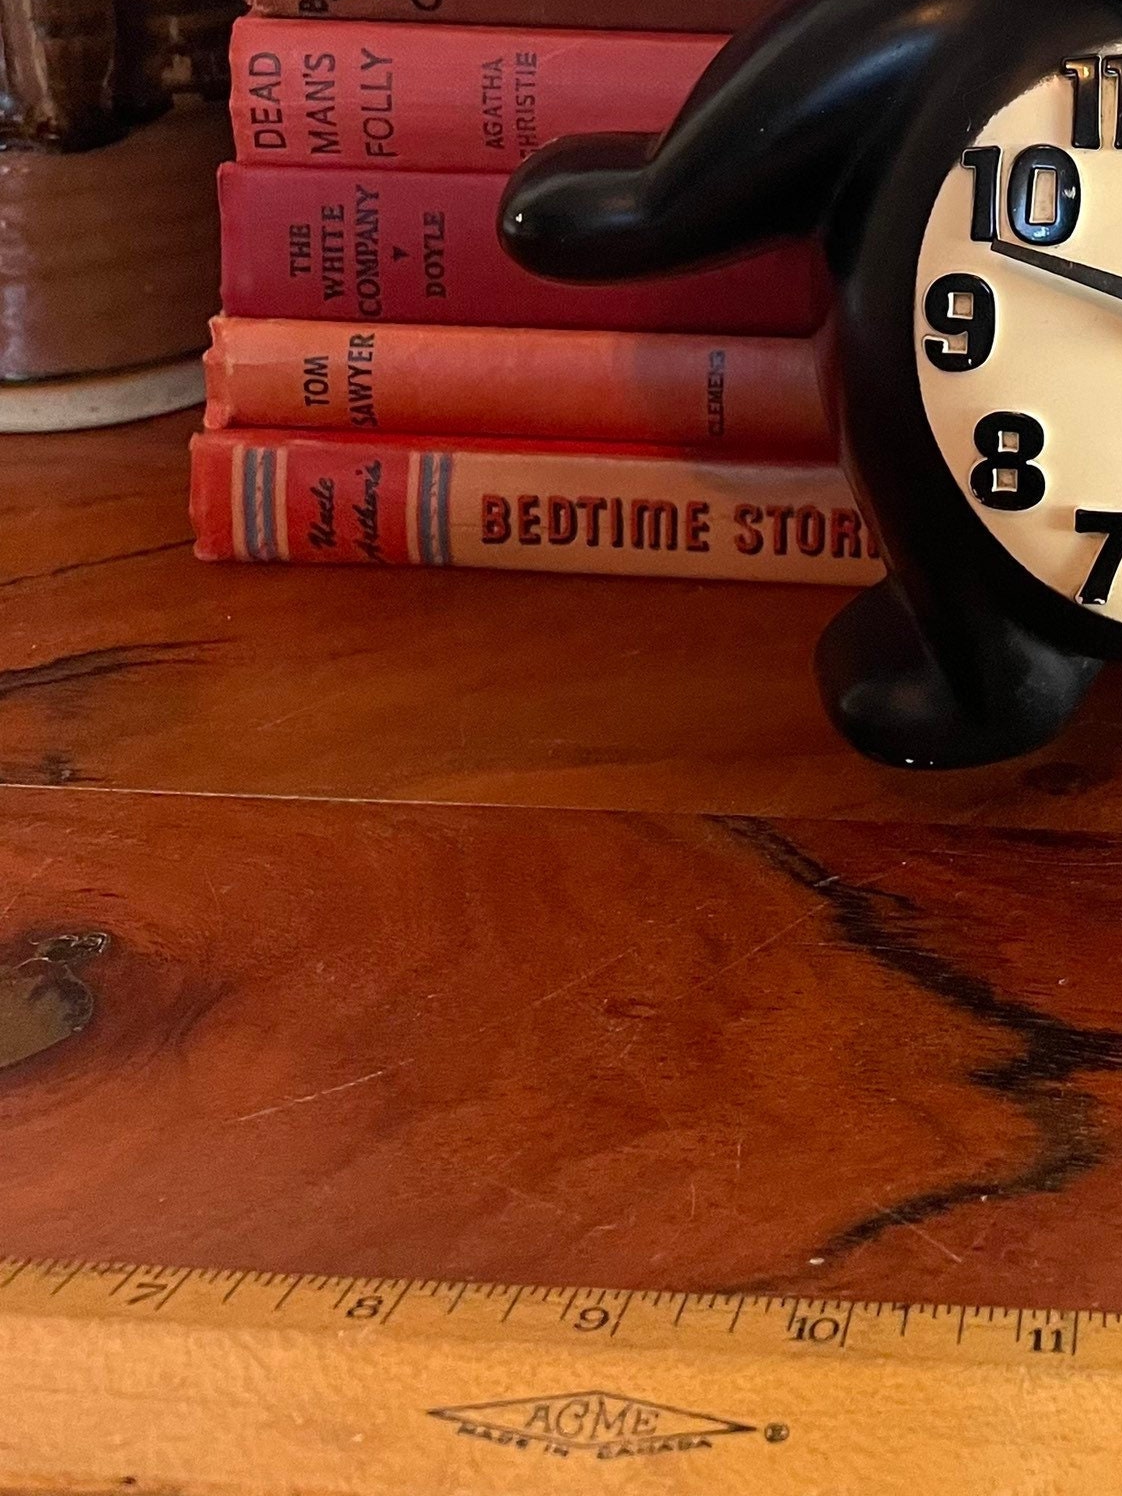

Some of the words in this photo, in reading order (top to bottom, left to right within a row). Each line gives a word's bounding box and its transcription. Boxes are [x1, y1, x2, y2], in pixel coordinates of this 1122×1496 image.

[248, 51, 287, 150] DEAD
[302, 53, 342, 155] MAN'S
[360, 48, 399, 158] FOLLY
[482, 58, 506, 150] AGATHA
[961, 144, 1082, 246] 10
[289, 224, 311, 277] THE
[321, 204, 344, 302] WHITE
[355, 184, 382, 318] COMPANY
[423, 211, 447, 299] DOYLE
[923, 273, 997, 372] 9
[303, 355, 330, 407] TOM
[348, 333, 379, 428] SAWYER
[970, 411, 1046, 511] 8
[481, 494, 710, 553] BEDTIME
[126, 1282, 168, 1305] 7
[346, 1294, 383, 1321] 8
[574, 1306, 610, 1334] 9
[794, 1315, 841, 1342] 10
[1029, 1327, 1064, 1354] 11
[525, 1398, 661, 1440] ACME
